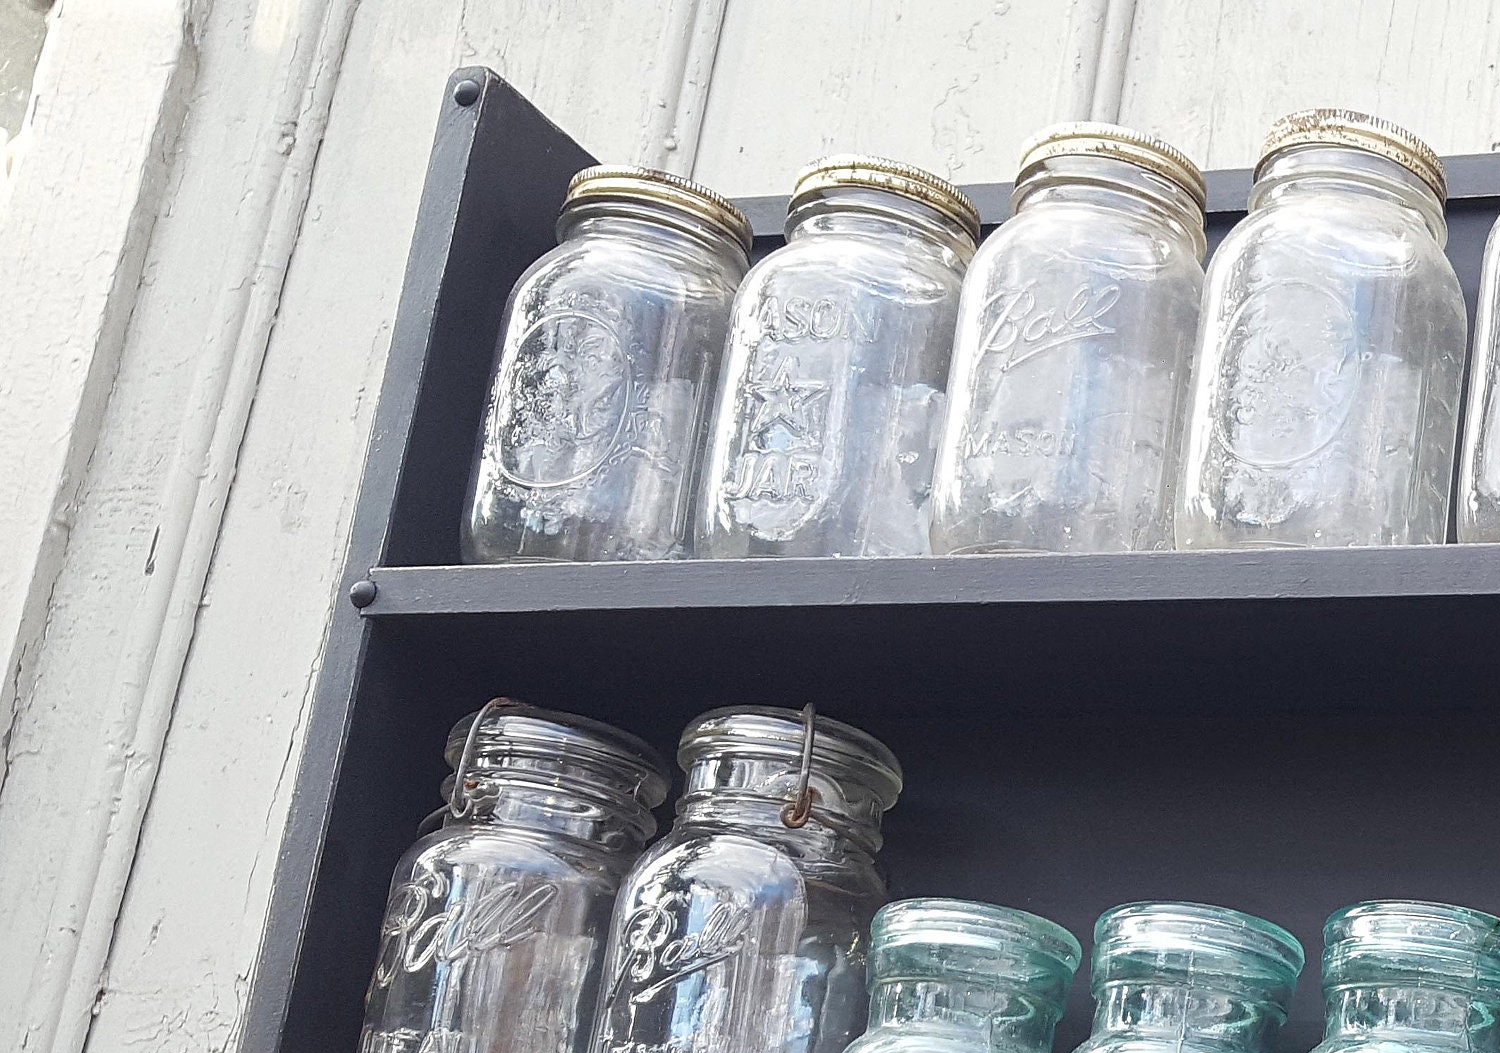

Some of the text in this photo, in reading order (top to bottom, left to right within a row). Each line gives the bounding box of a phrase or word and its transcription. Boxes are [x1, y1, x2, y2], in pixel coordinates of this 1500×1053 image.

[973, 281, 1121, 372] Ball
[723, 453, 819, 500] JAR
[964, 428, 1076, 459] MASON
[376, 870, 559, 990] Ball
[605, 888, 757, 1004] Ball
